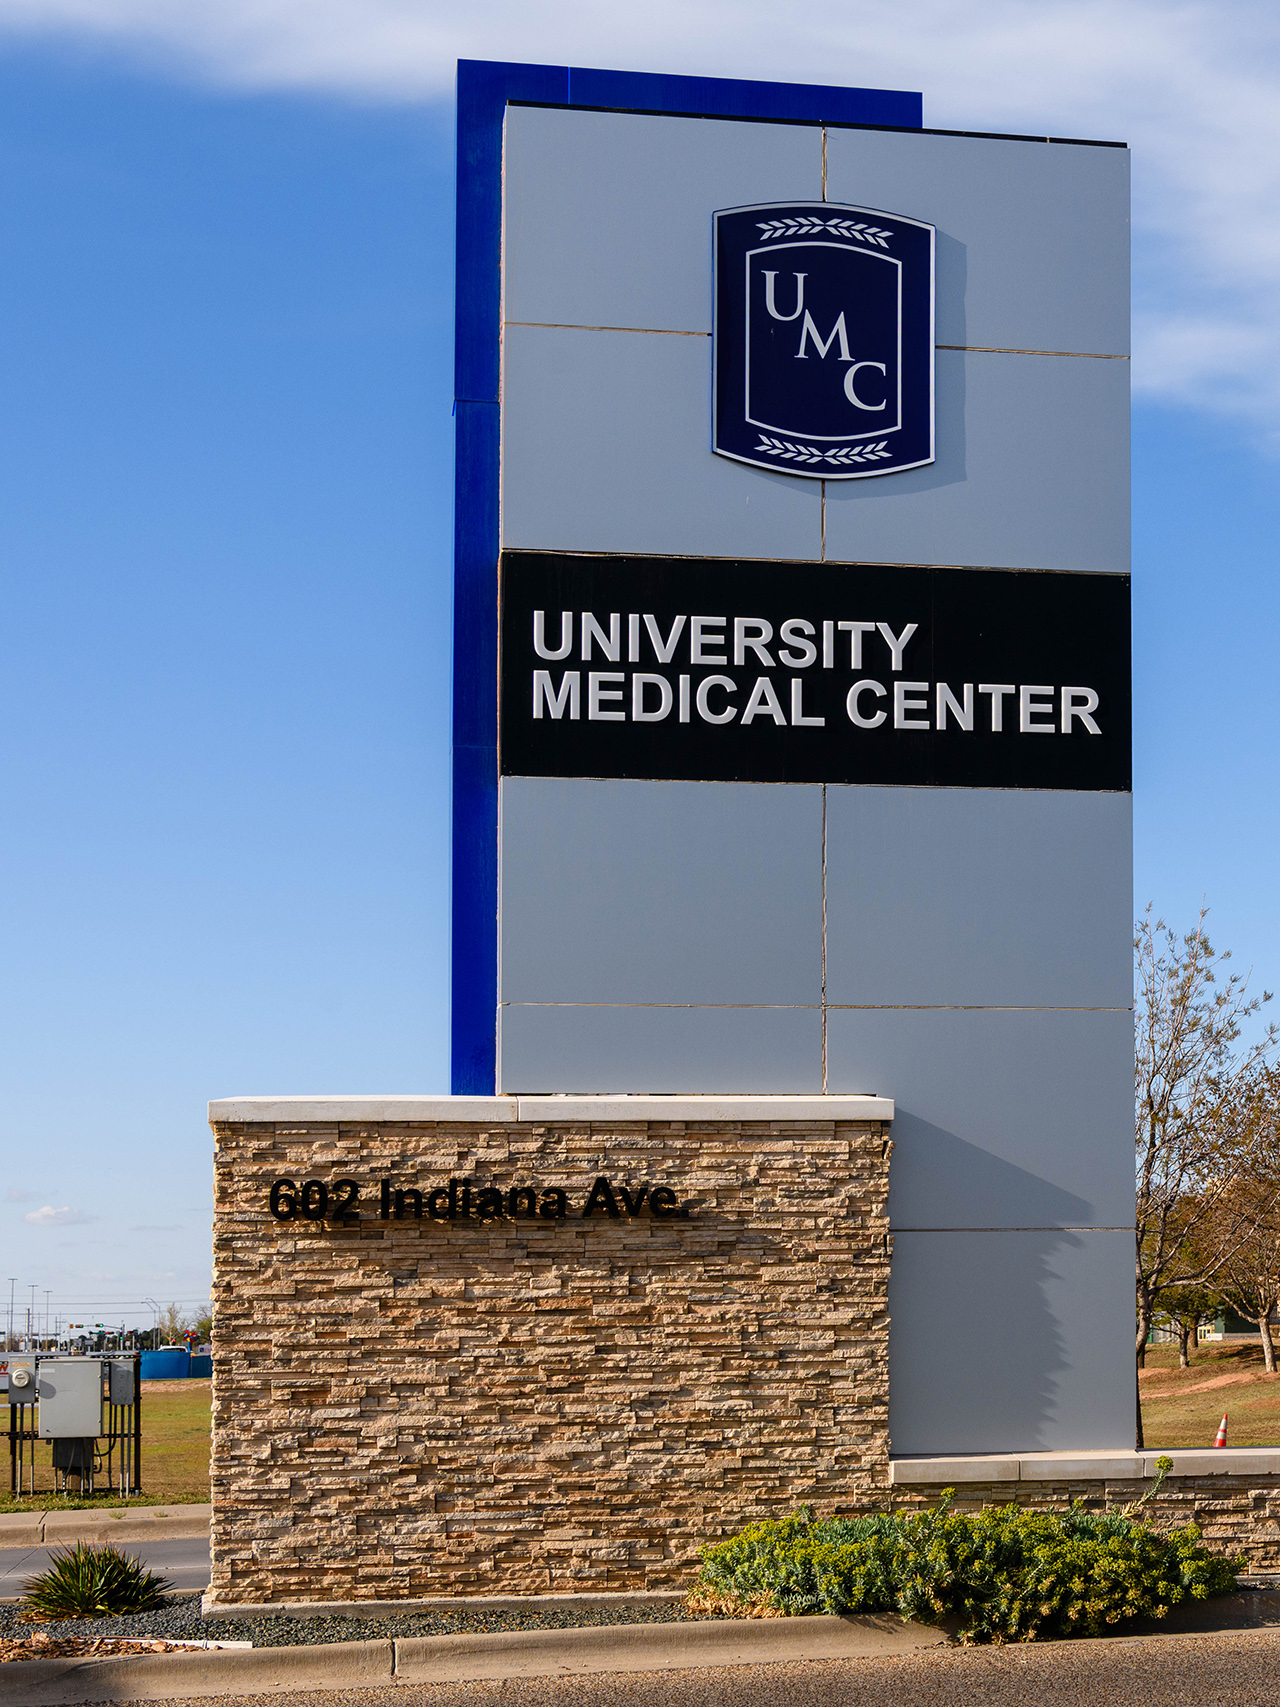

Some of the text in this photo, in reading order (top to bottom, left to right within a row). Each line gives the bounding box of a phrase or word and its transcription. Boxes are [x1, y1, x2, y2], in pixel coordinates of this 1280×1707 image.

[761, 270, 886, 411] UMC
[533, 610, 918, 671] UNIVERSITY
[533, 670, 1102, 735] MEDICAL CENTER
[269, 1176, 691, 1221] 602 Indiana Ave.
